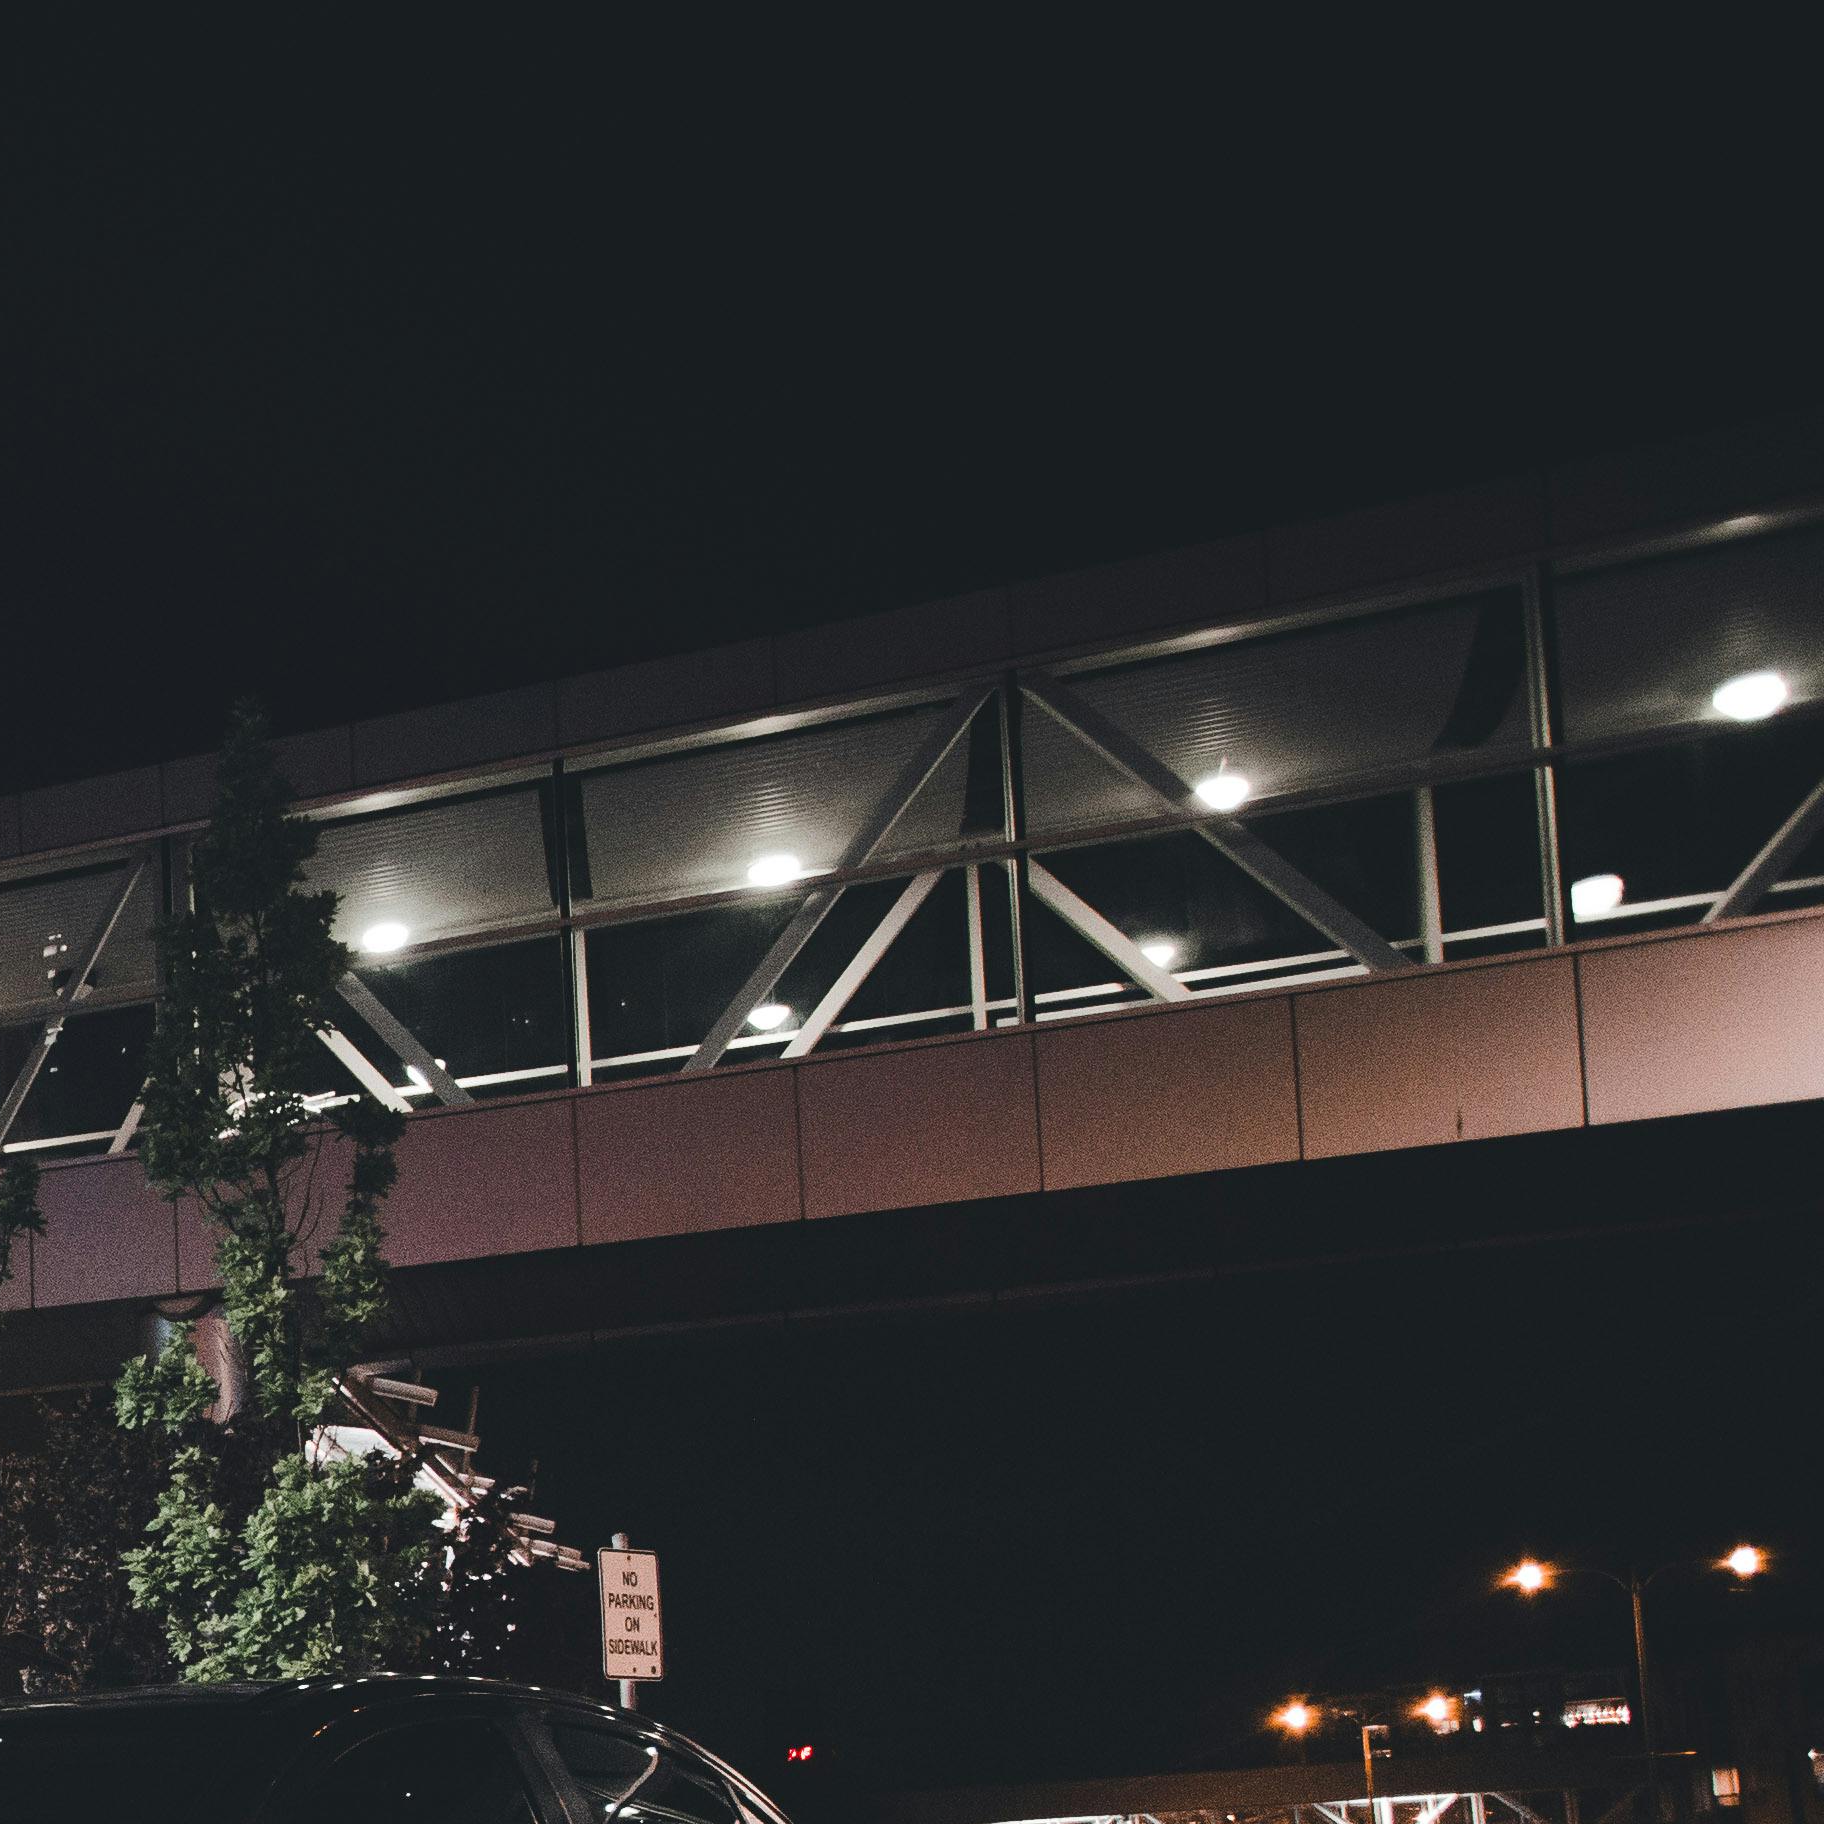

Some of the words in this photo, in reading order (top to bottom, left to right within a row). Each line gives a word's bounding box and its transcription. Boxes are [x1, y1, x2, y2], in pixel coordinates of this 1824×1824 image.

[622, 1571, 638, 1587] NO
[608, 1593, 654, 1611] PARKING
[624, 1617, 640, 1633] ON
[608, 1639, 658, 1657] SIDEWALK
